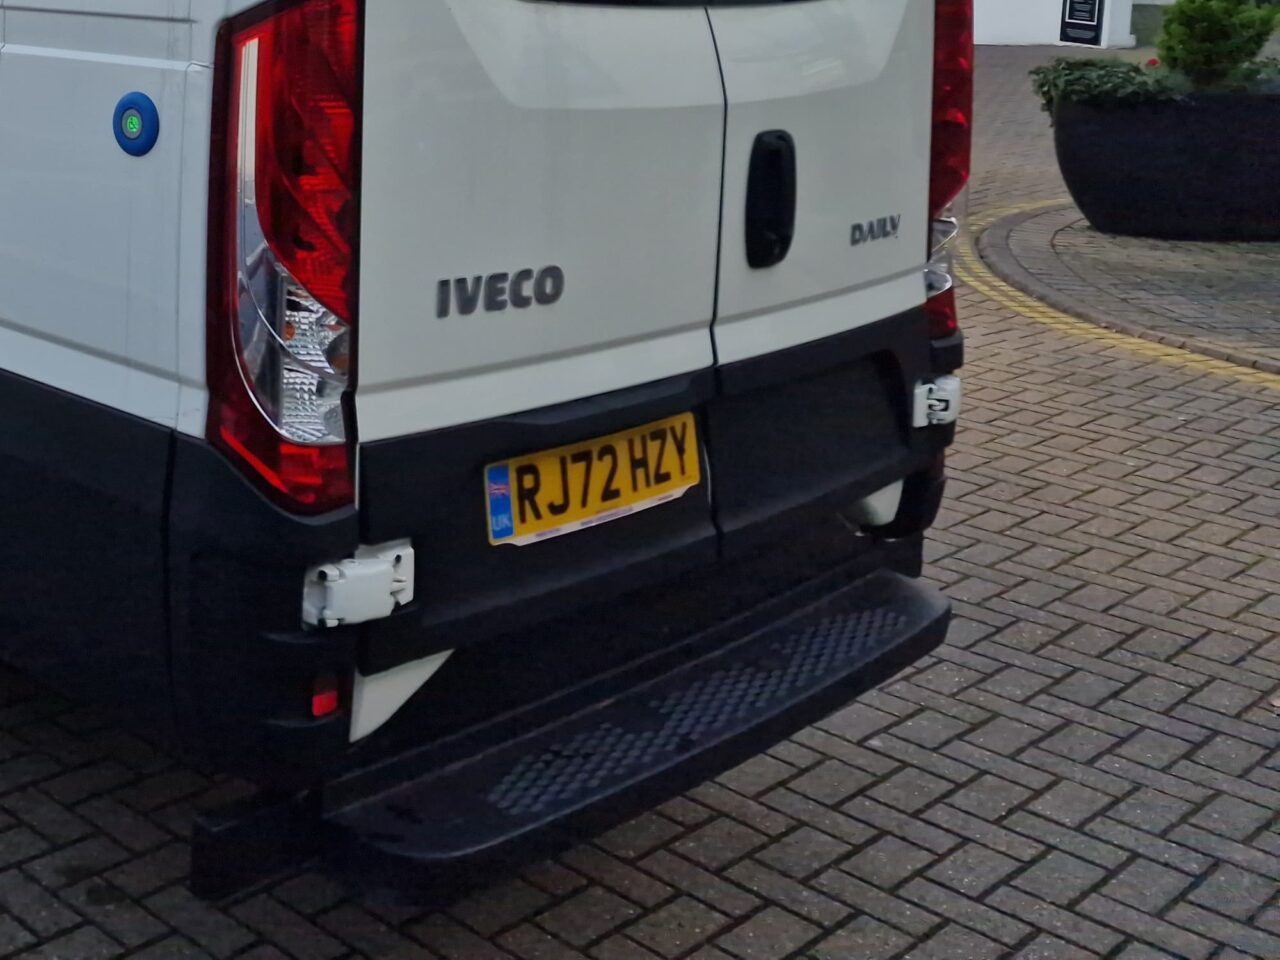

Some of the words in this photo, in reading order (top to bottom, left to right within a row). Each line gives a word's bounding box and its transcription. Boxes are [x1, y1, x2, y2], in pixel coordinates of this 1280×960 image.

[850, 213, 901, 247] DAILY
[436, 265, 565, 319] IVECO
[516, 444, 621, 524] RJ72
[627, 422, 687, 492] HZY
[492, 514, 513, 531] UK
